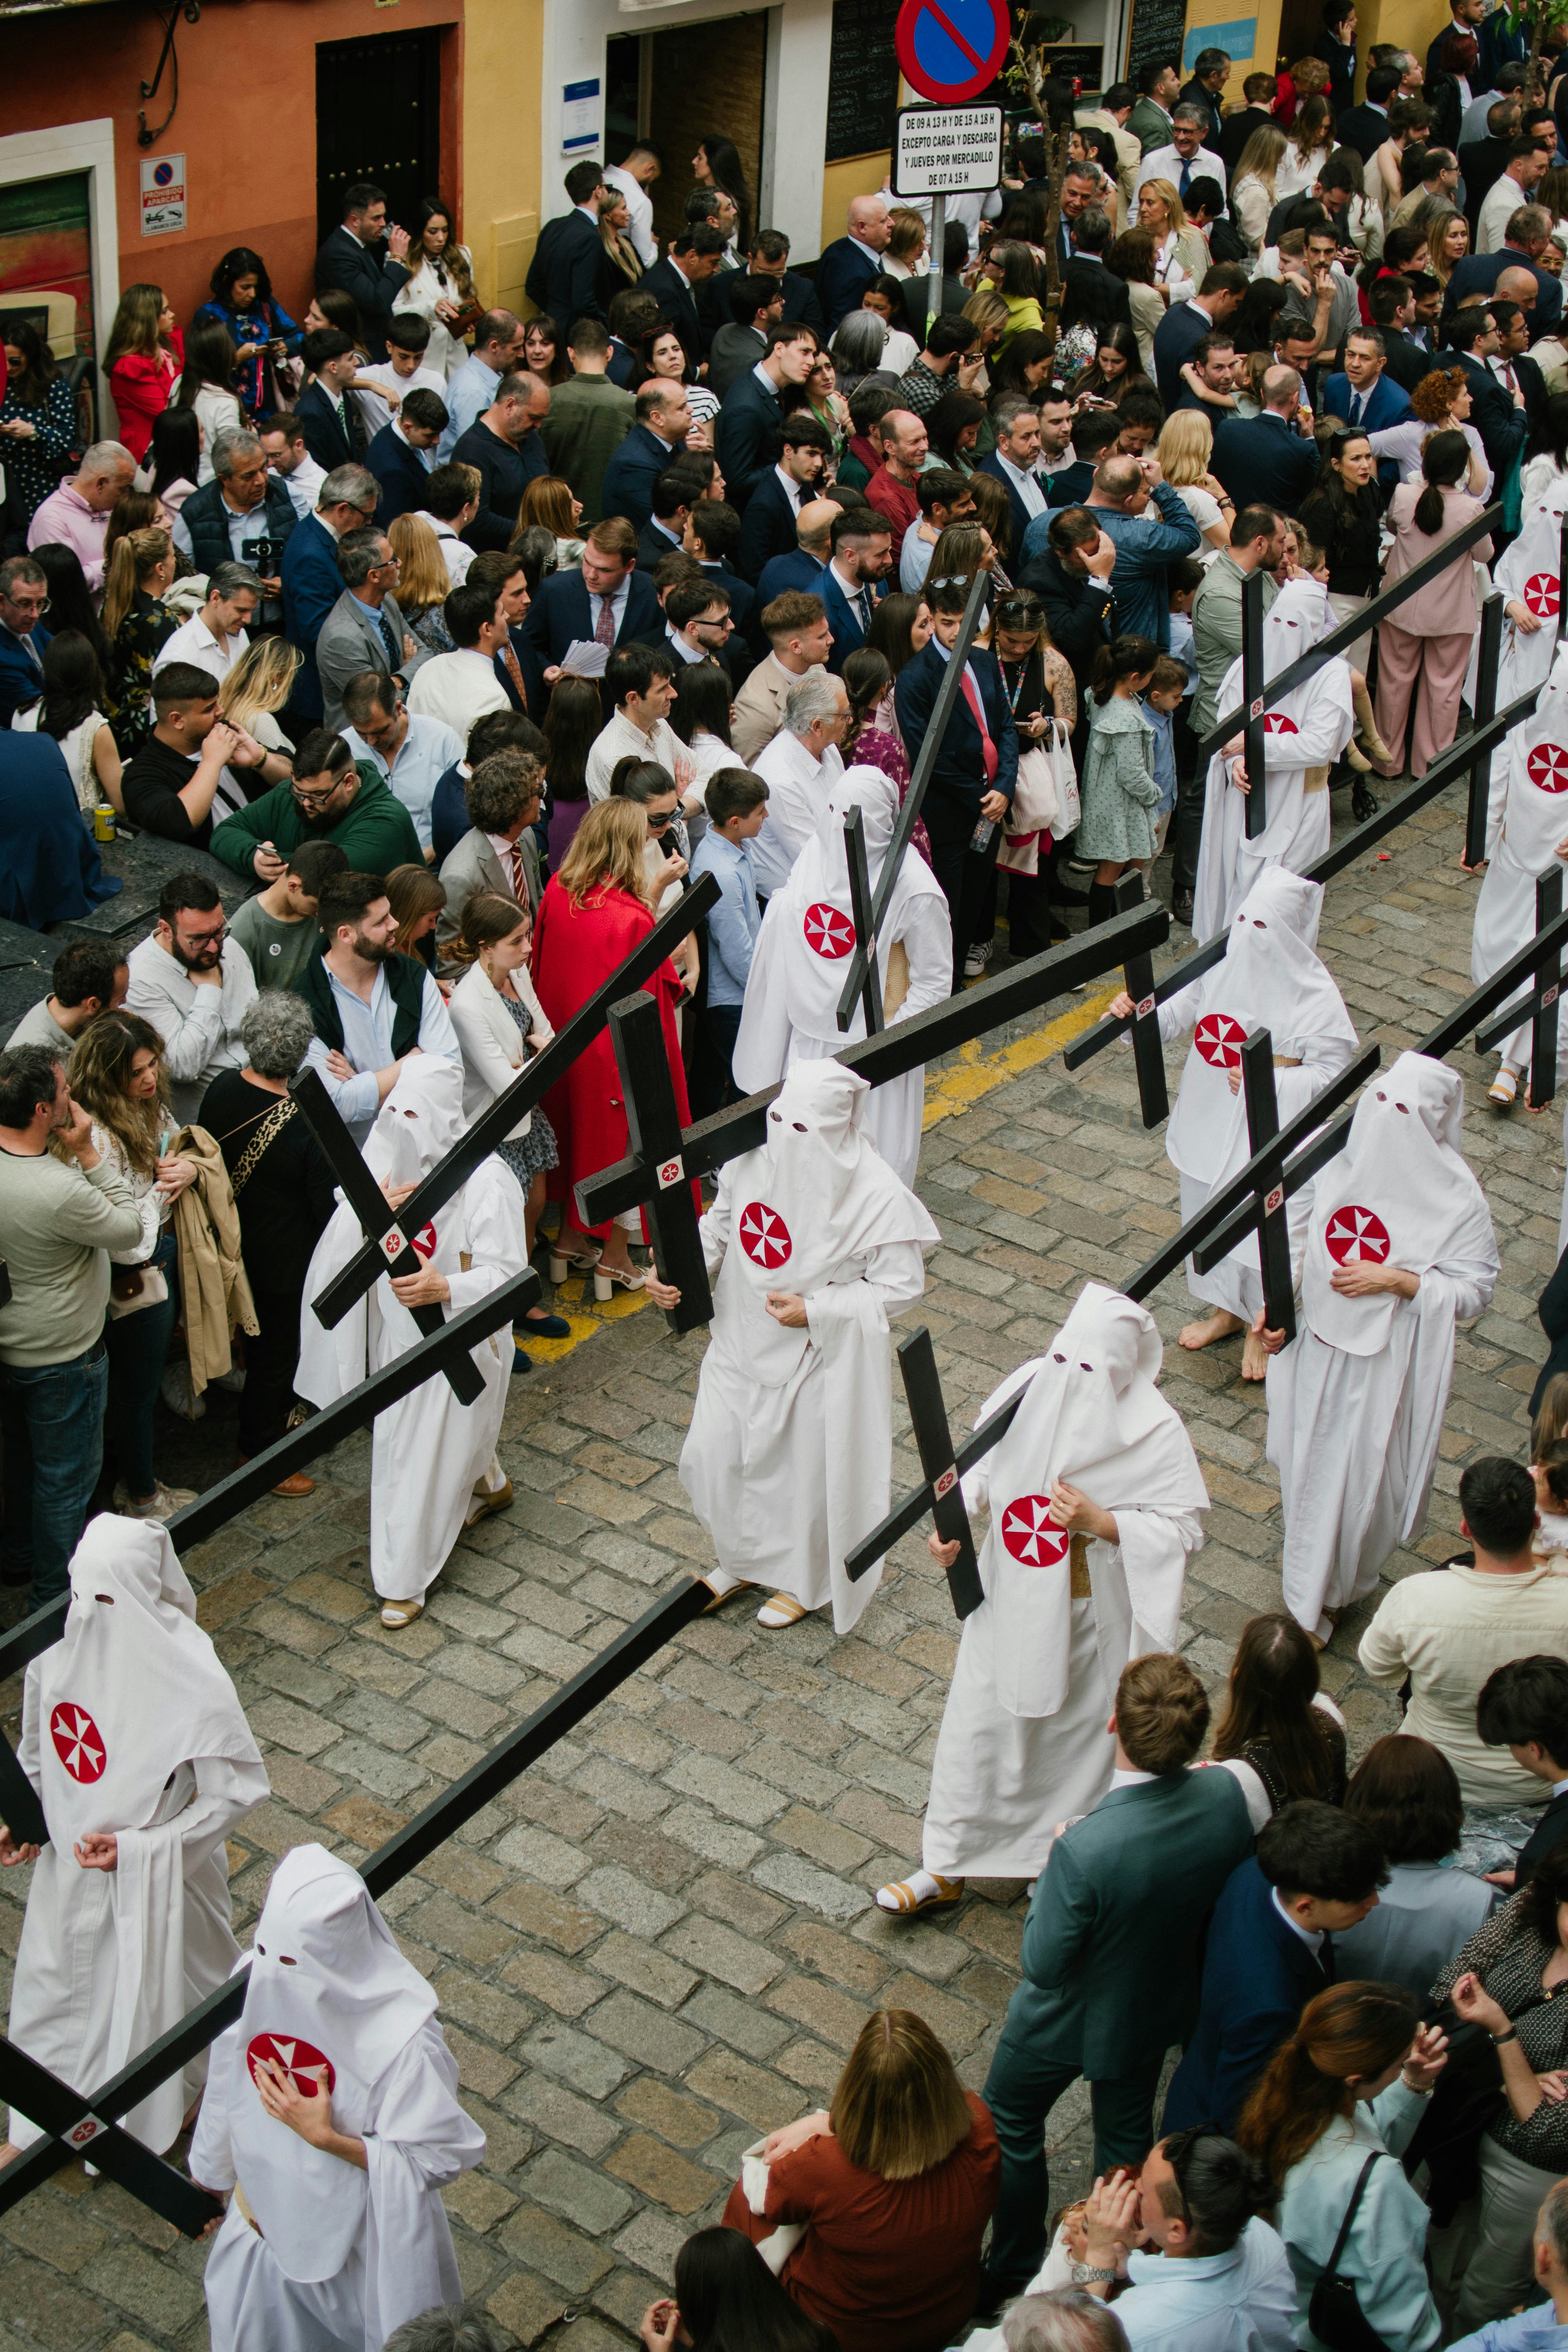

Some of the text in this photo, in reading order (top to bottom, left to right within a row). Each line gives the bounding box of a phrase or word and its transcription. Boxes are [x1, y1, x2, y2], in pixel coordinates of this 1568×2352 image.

[906, 113, 994, 130] DE 09 A 13 H Y DE 15 A 18 H
[902, 137, 931, 149] EXCEPTO
[933, 135, 955, 147] CARGA
[957, 135, 961, 144] Y
[963, 132, 996, 144] DESCARGA
[906, 151, 993, 168] Y JUEVES POR MERCADILLO
[929, 172, 968, 185] DE 07 A 15 H
[144, 186, 182, 199] PROHIBIDO
[147, 194, 180, 206] APARCAR
